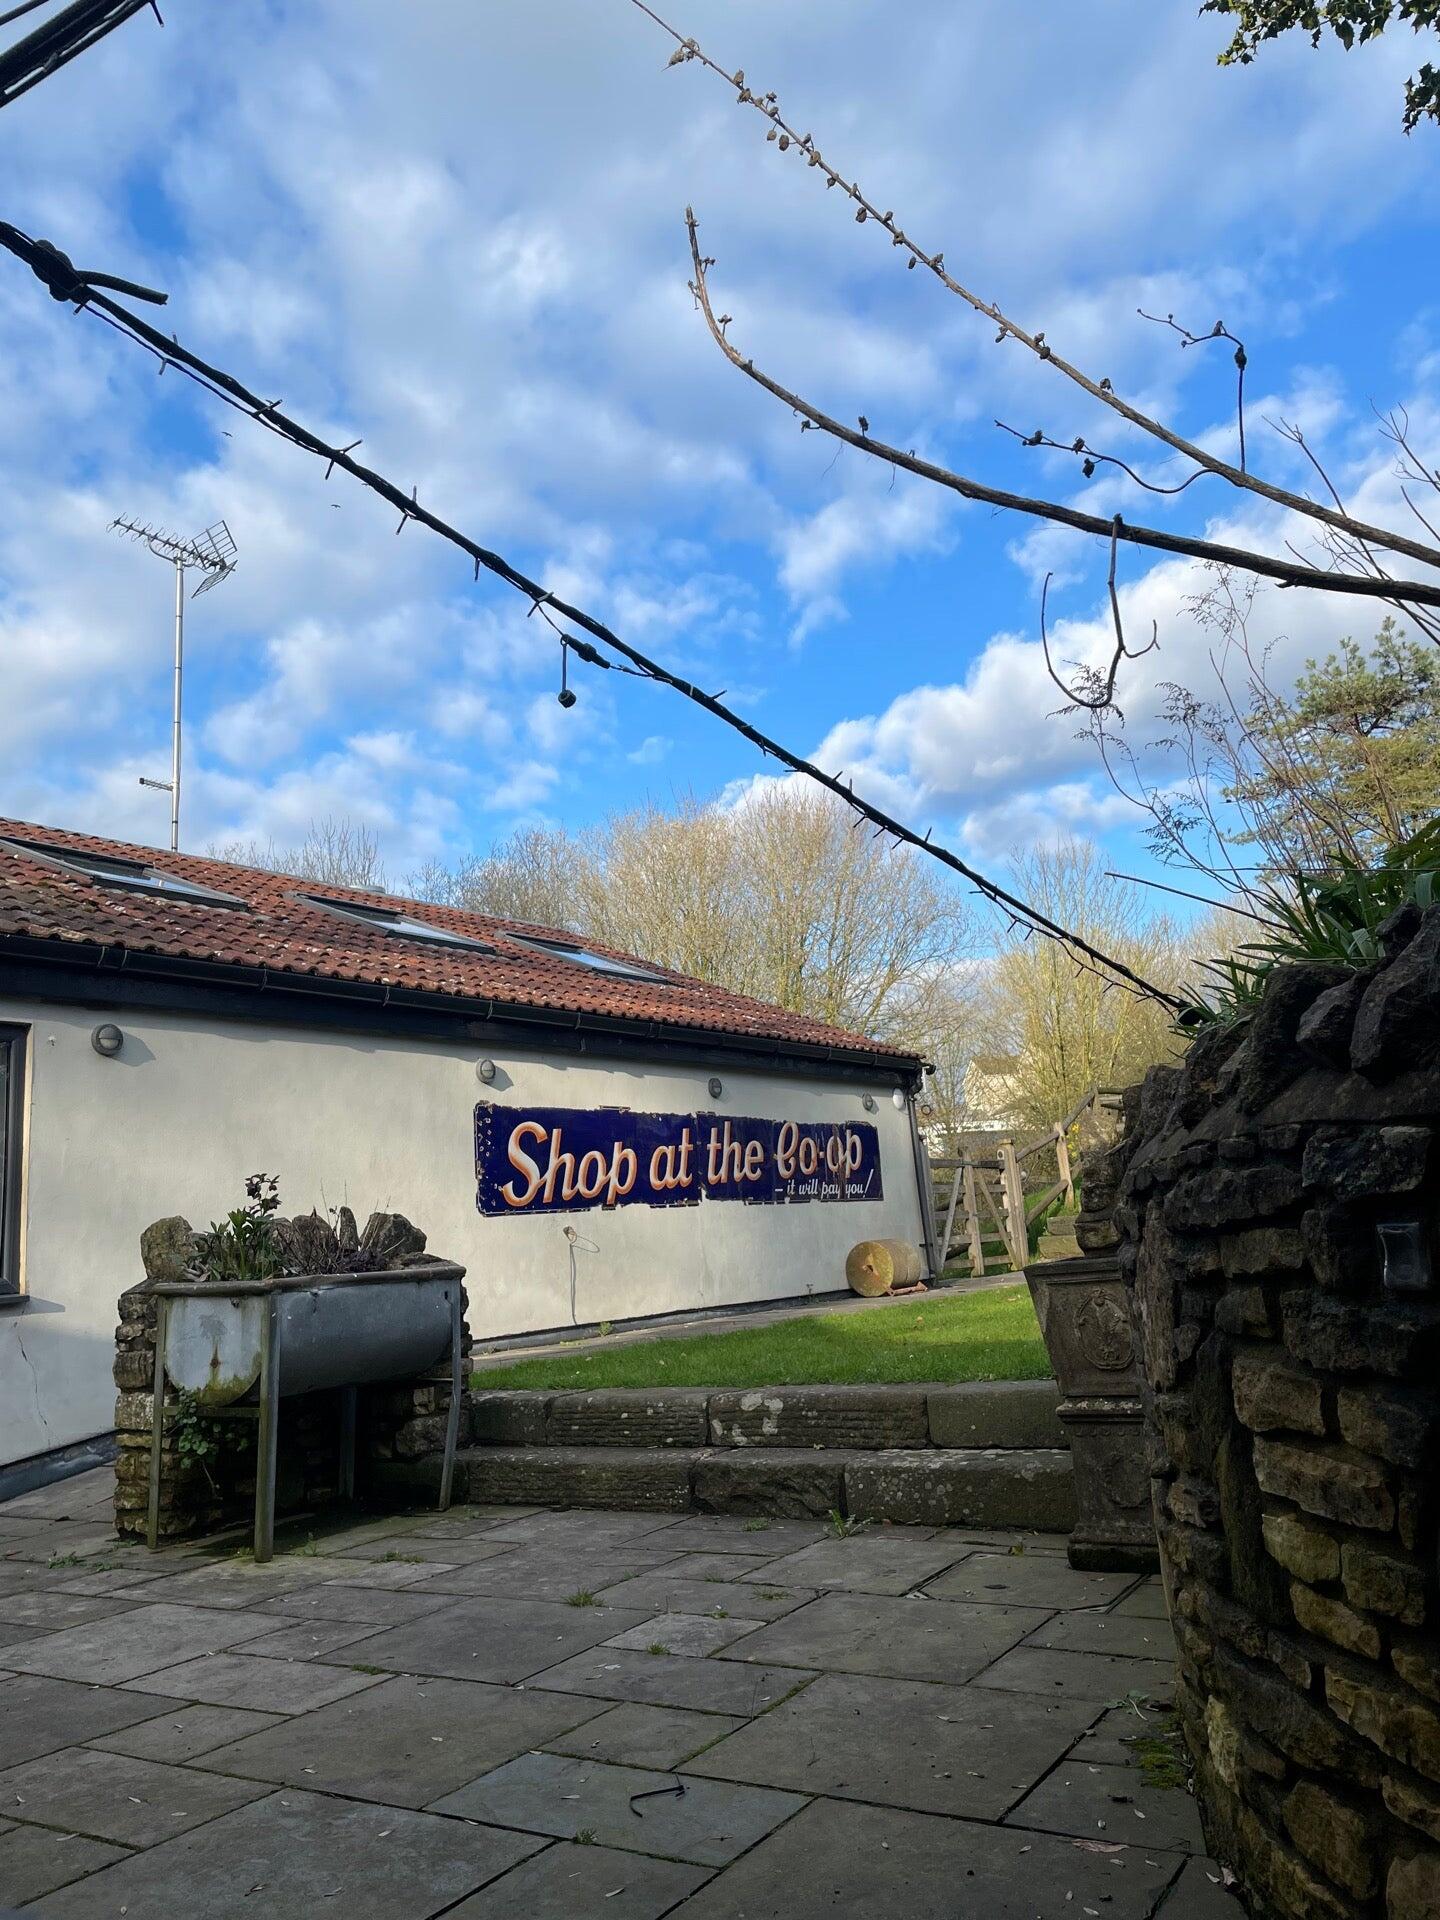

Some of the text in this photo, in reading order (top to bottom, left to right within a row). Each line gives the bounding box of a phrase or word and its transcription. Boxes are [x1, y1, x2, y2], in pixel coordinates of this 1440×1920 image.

[502, 1120, 862, 1207] Shop at the Co-op
[786, 1179, 796, 1195] it
[798, 1178, 818, 1195] will
[821, 1181, 840, 1200] pay
[845, 1168, 874, 1199] you!
